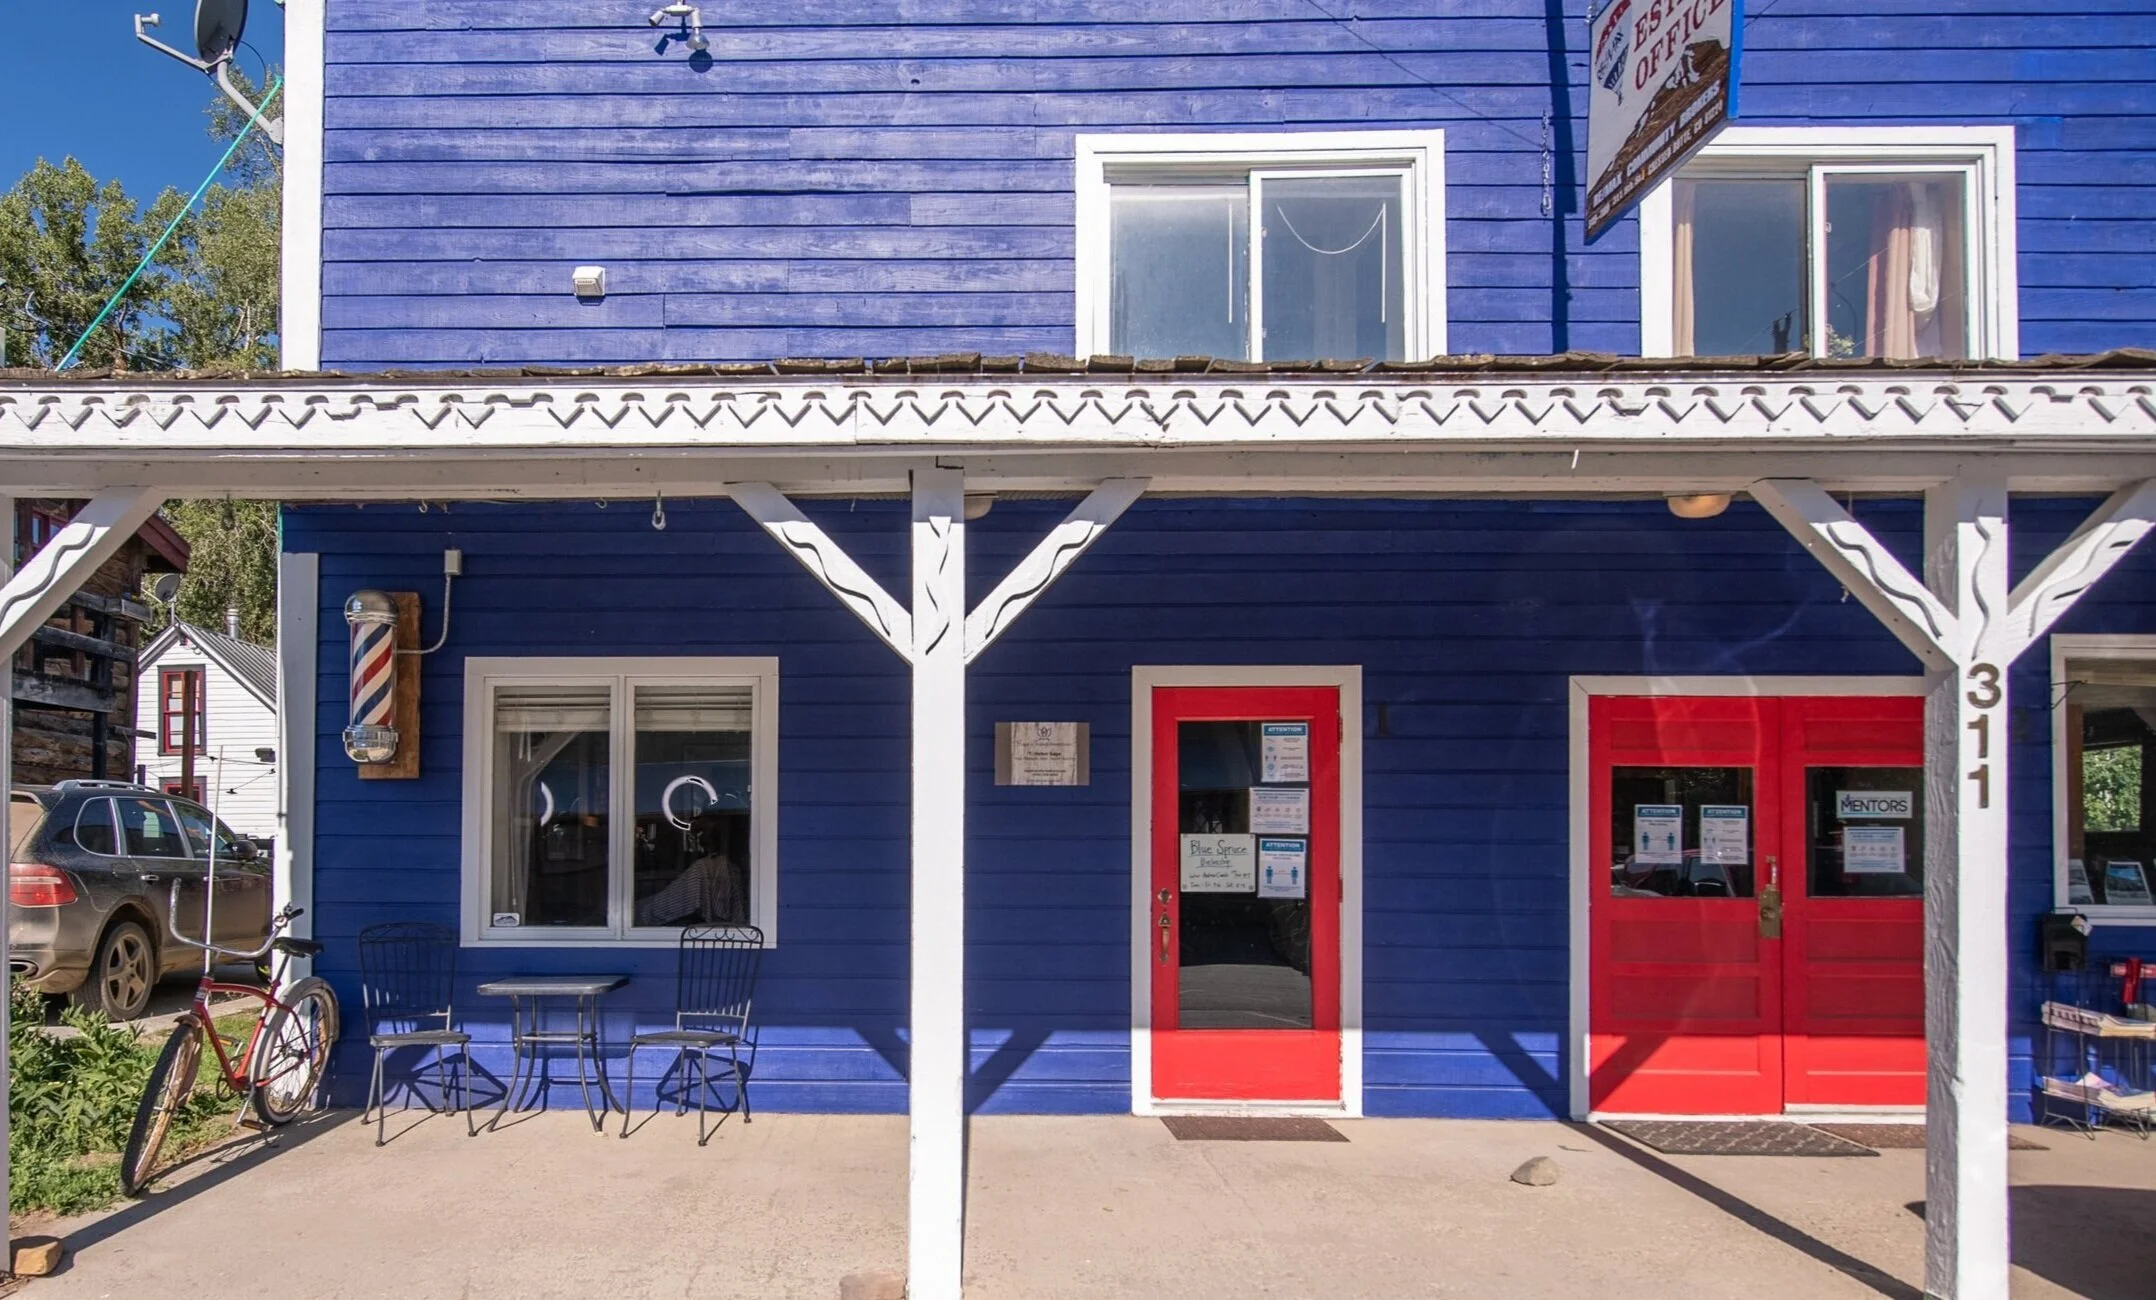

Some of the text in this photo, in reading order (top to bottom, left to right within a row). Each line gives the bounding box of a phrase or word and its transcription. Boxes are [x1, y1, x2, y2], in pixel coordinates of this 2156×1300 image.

[1966, 662, 2002, 809] 311
[1840, 799, 1909, 813] MENTORS
[1190, 839, 1247, 859] Blue Spruce
